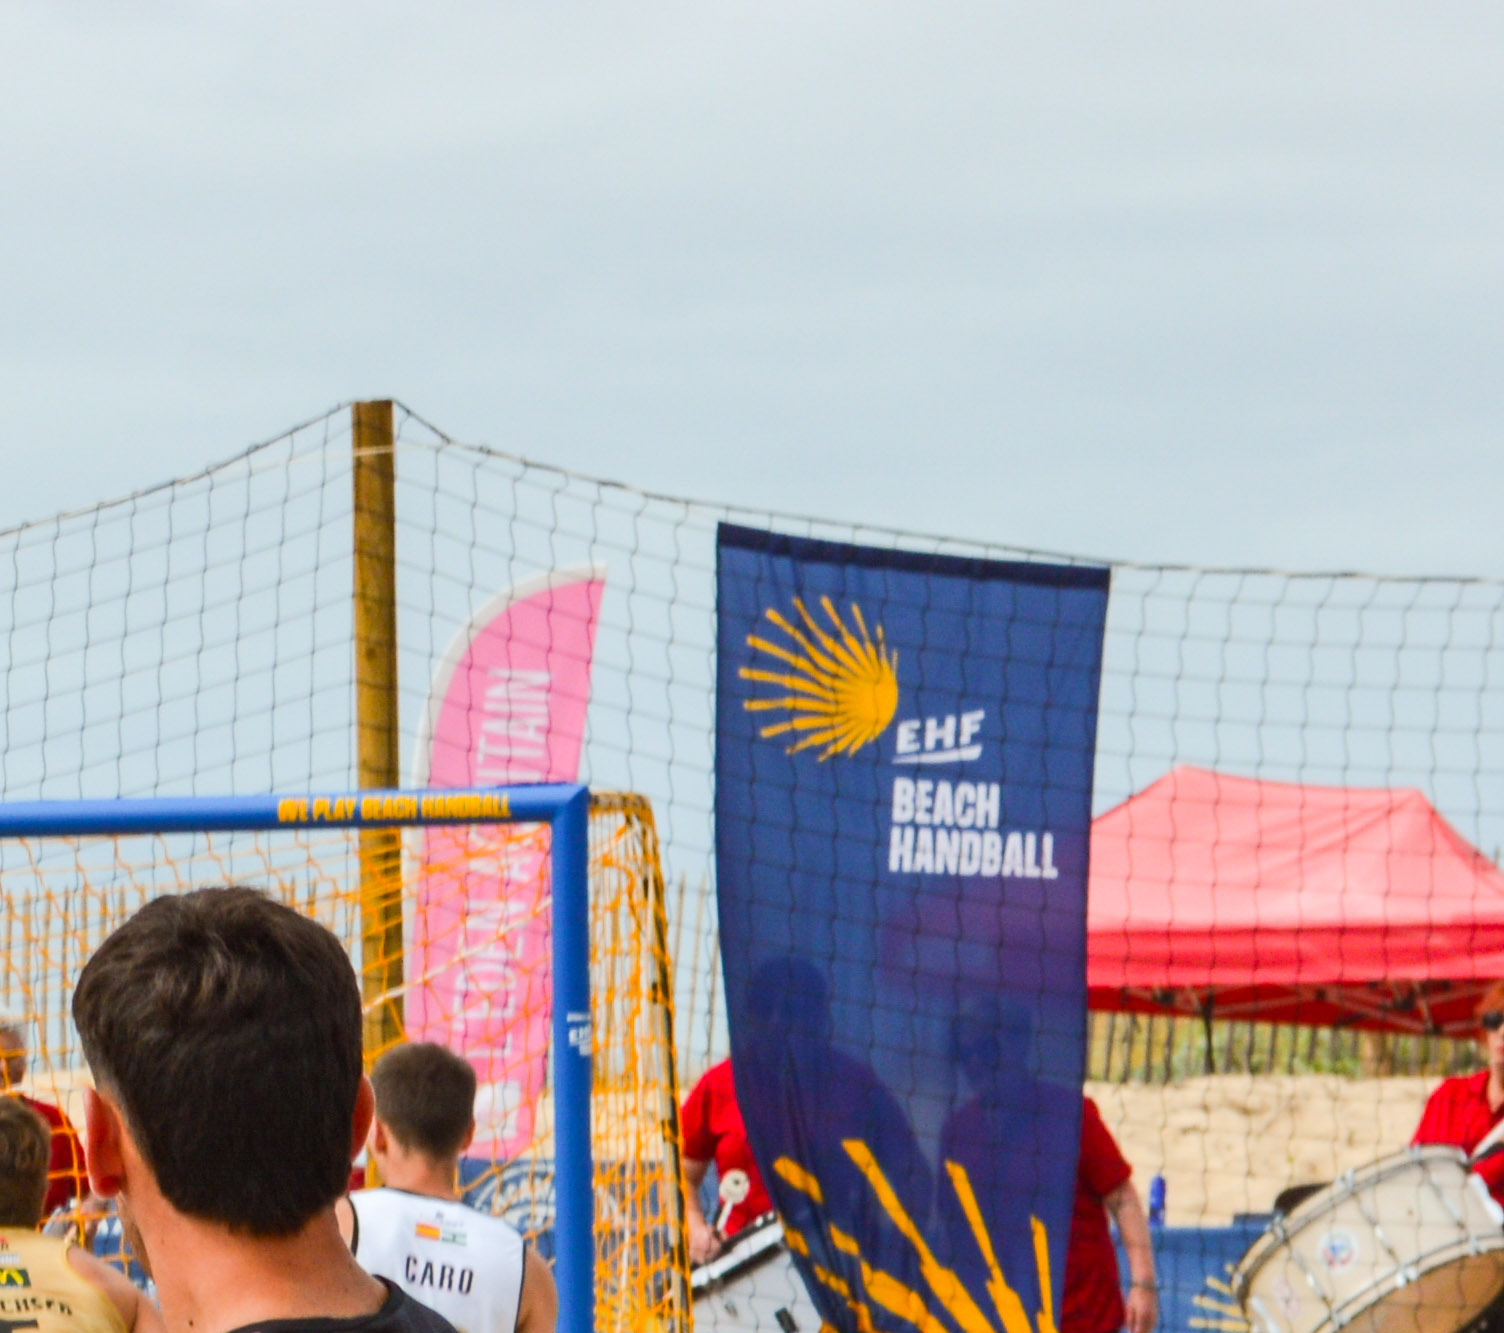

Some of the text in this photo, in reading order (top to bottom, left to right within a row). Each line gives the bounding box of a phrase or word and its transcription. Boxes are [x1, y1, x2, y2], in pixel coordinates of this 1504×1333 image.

[896, 710, 985, 755] EHF
[361, 796, 418, 821] BEACH
[421, 792, 512, 819] HANDBALL
[893, 777, 1000, 829] BEACH
[889, 826, 1058, 880] HANDBALL
[404, 1255, 474, 1296] CARO
